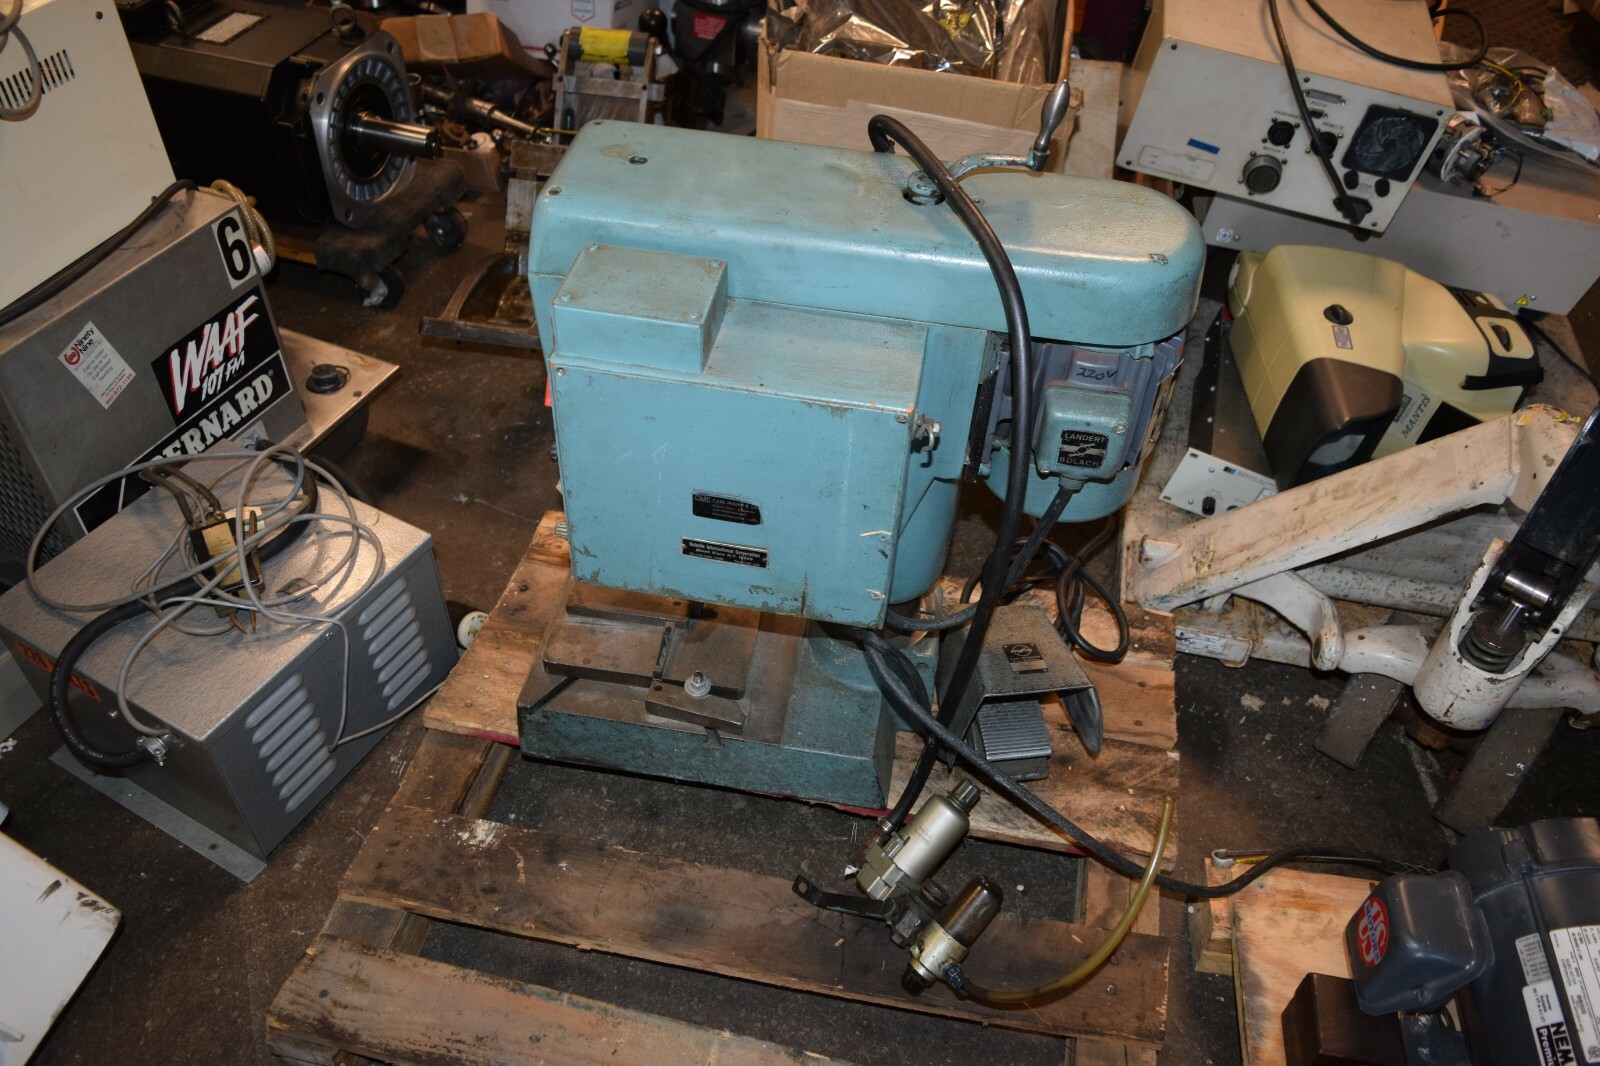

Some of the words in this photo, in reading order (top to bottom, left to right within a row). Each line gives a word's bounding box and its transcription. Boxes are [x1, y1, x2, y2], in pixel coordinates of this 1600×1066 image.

[217, 216, 251, 281] 6
[74, 327, 95, 350] Ninety
[79, 339, 94, 355] Nine
[169, 295, 259, 416] WAAF
[201, 363, 225, 402] 107
[225, 350, 246, 382] FM
[151, 373, 273, 460] ERNARD
[1064, 432, 1105, 443] LANDERT
[1402, 394, 1430, 438] MANTIS
